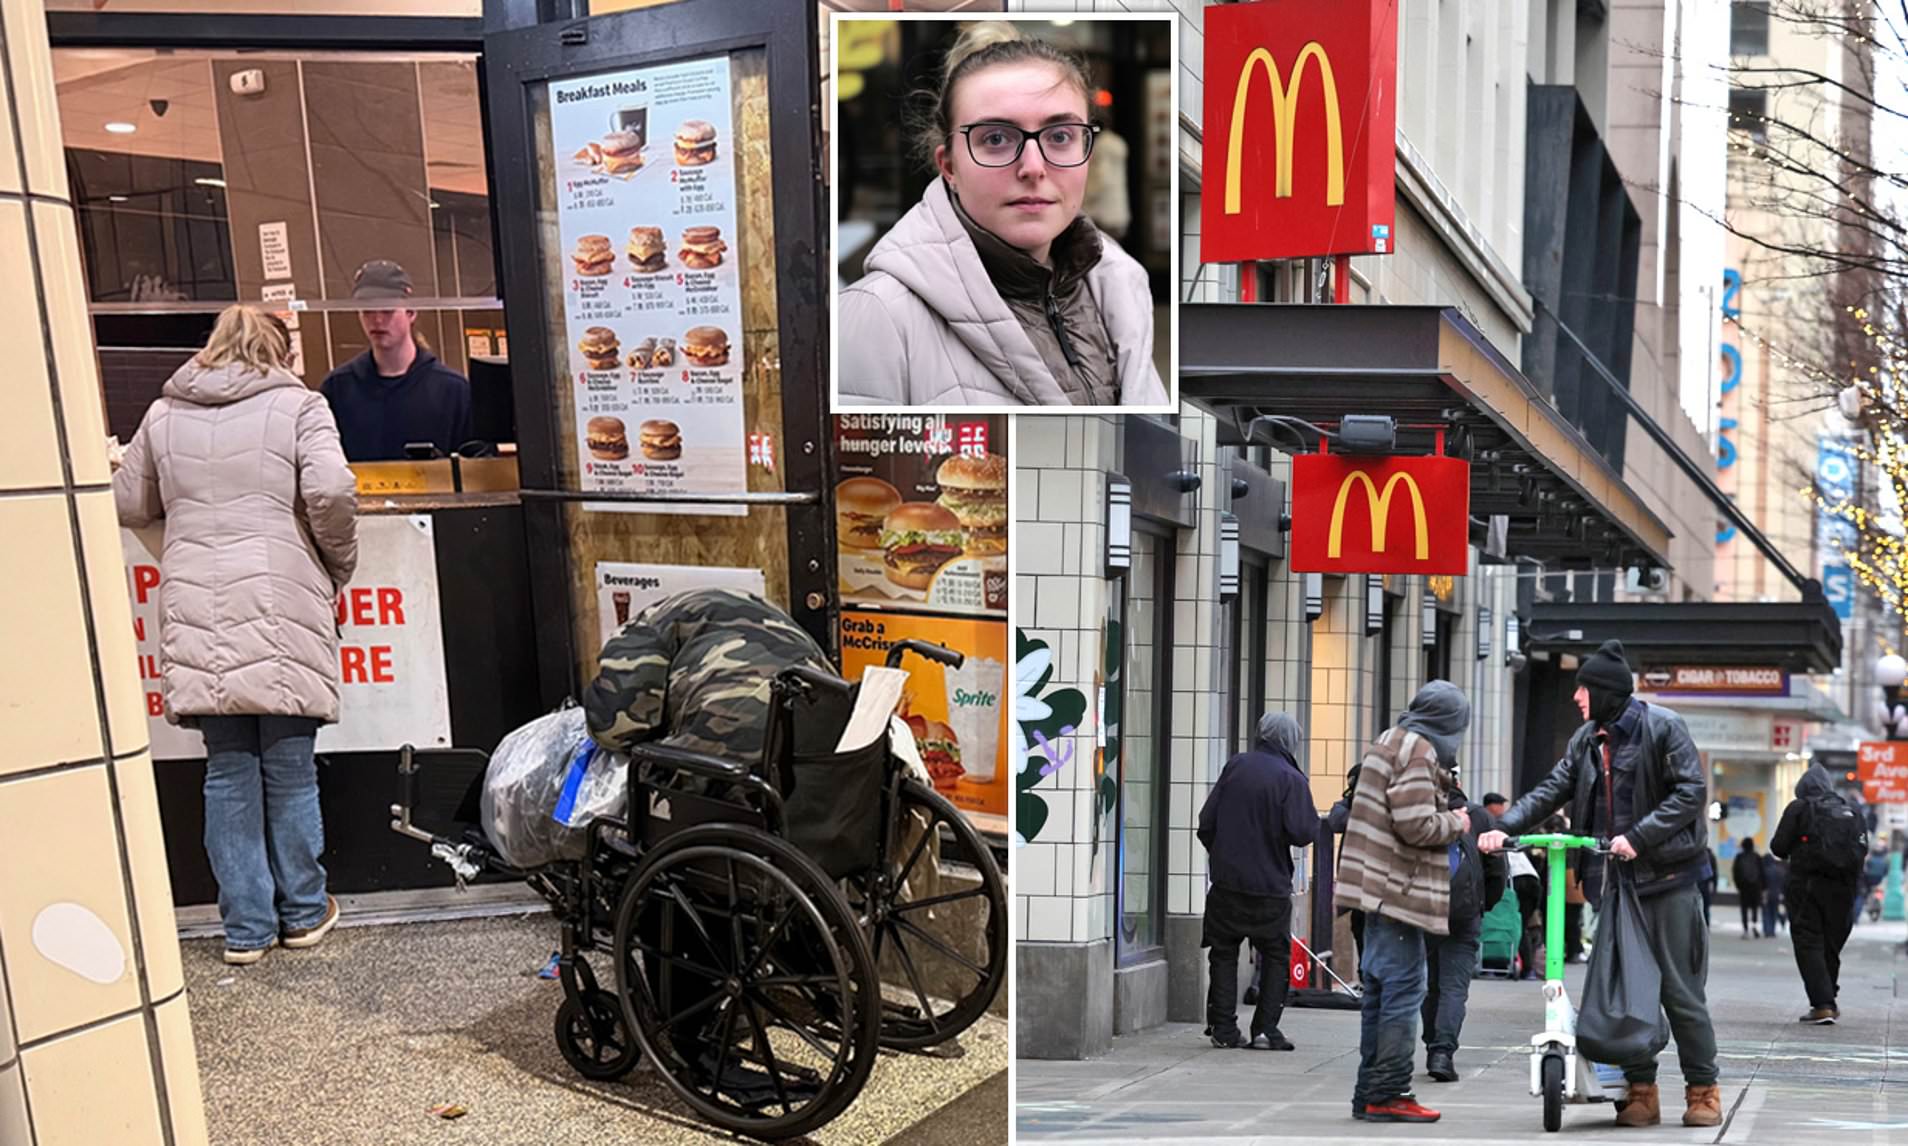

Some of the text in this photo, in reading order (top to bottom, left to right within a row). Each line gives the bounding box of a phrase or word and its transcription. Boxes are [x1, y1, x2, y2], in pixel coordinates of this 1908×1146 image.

[556, 84, 610, 104] Breakfast
[611, 79, 648, 96] Meals
[671, 170, 677, 182] 2
[572, 279, 579, 291] 3
[623, 277, 630, 288] 4
[676, 273, 683, 285] 5
[579, 372, 586, 384] 6
[630, 372, 636, 383] 7
[682, 370, 689, 382] 8
[840, 414, 921, 433] Satisfying
[840, 436, 898, 457] hunger
[586, 463, 592, 474] 9
[632, 463, 645, 475] 10
[604, 574, 660, 589] Beverages
[842, 618, 885, 634] Grab a
[1677, 670, 1713, 684] CIGAR
[1725, 669, 1780, 684] TOBACCO
[953, 688, 996, 707] Sprite
[1861, 745, 1895, 763] 3rd
